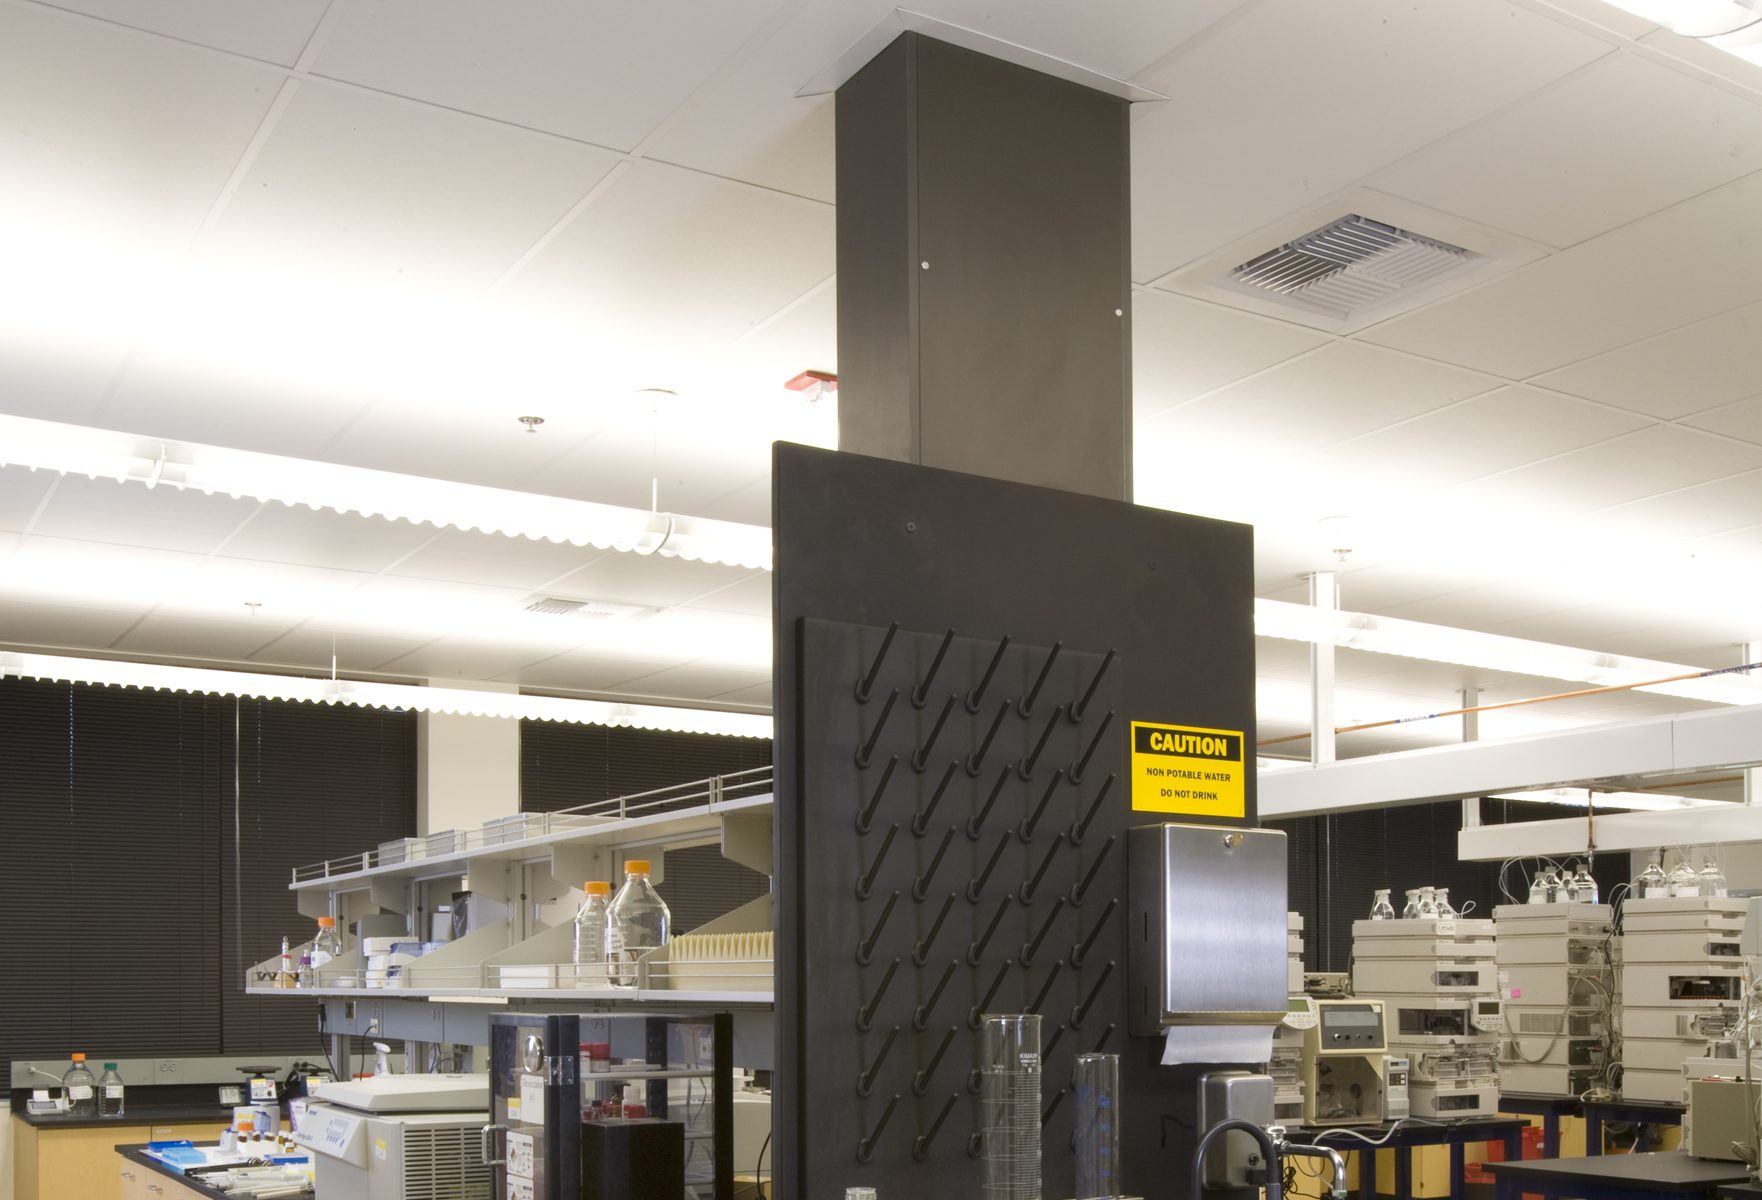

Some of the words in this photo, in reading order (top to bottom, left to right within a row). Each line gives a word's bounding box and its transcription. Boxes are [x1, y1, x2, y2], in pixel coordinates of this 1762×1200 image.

[1150, 732, 1227, 757] CAUTION
[1146, 767, 1165, 777] NON
[1166, 769, 1203, 780] POTABLE
[1204, 772, 1231, 783] WATER
[1160, 788, 1173, 797] DO
[1174, 789, 1191, 799] NOT
[1192, 791, 1218, 801] DRINK
